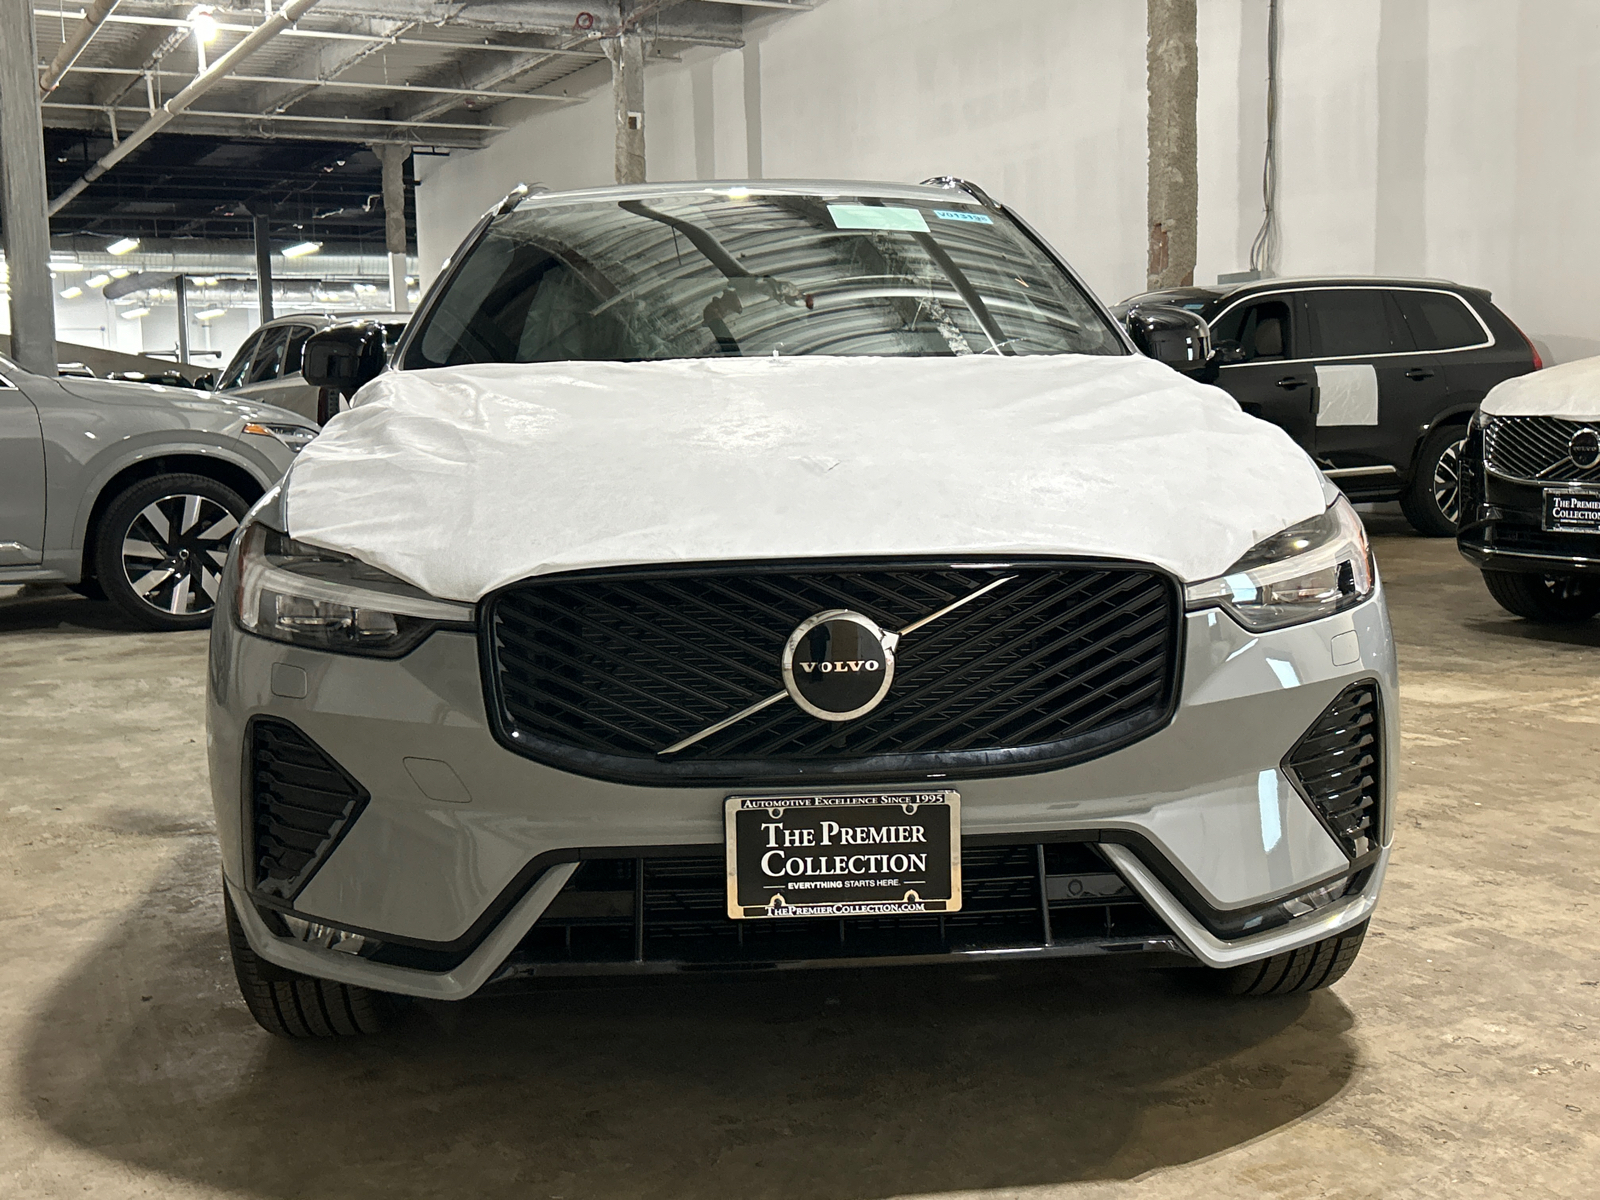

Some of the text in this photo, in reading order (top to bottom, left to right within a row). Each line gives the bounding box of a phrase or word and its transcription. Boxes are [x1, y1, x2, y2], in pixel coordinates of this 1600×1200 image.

[1553, 497, 1600, 509] THE PREMIE
[799, 660, 879, 673] VOLVO
[743, 794, 943, 809] AUTOMOTIVE EXCELLENCE SINCE 1995
[760, 820, 927, 848] THE PREMIER
[761, 850, 928, 877] COLLECTION
[787, 878, 901, 890] EVERYTHING STARTS HERE.
